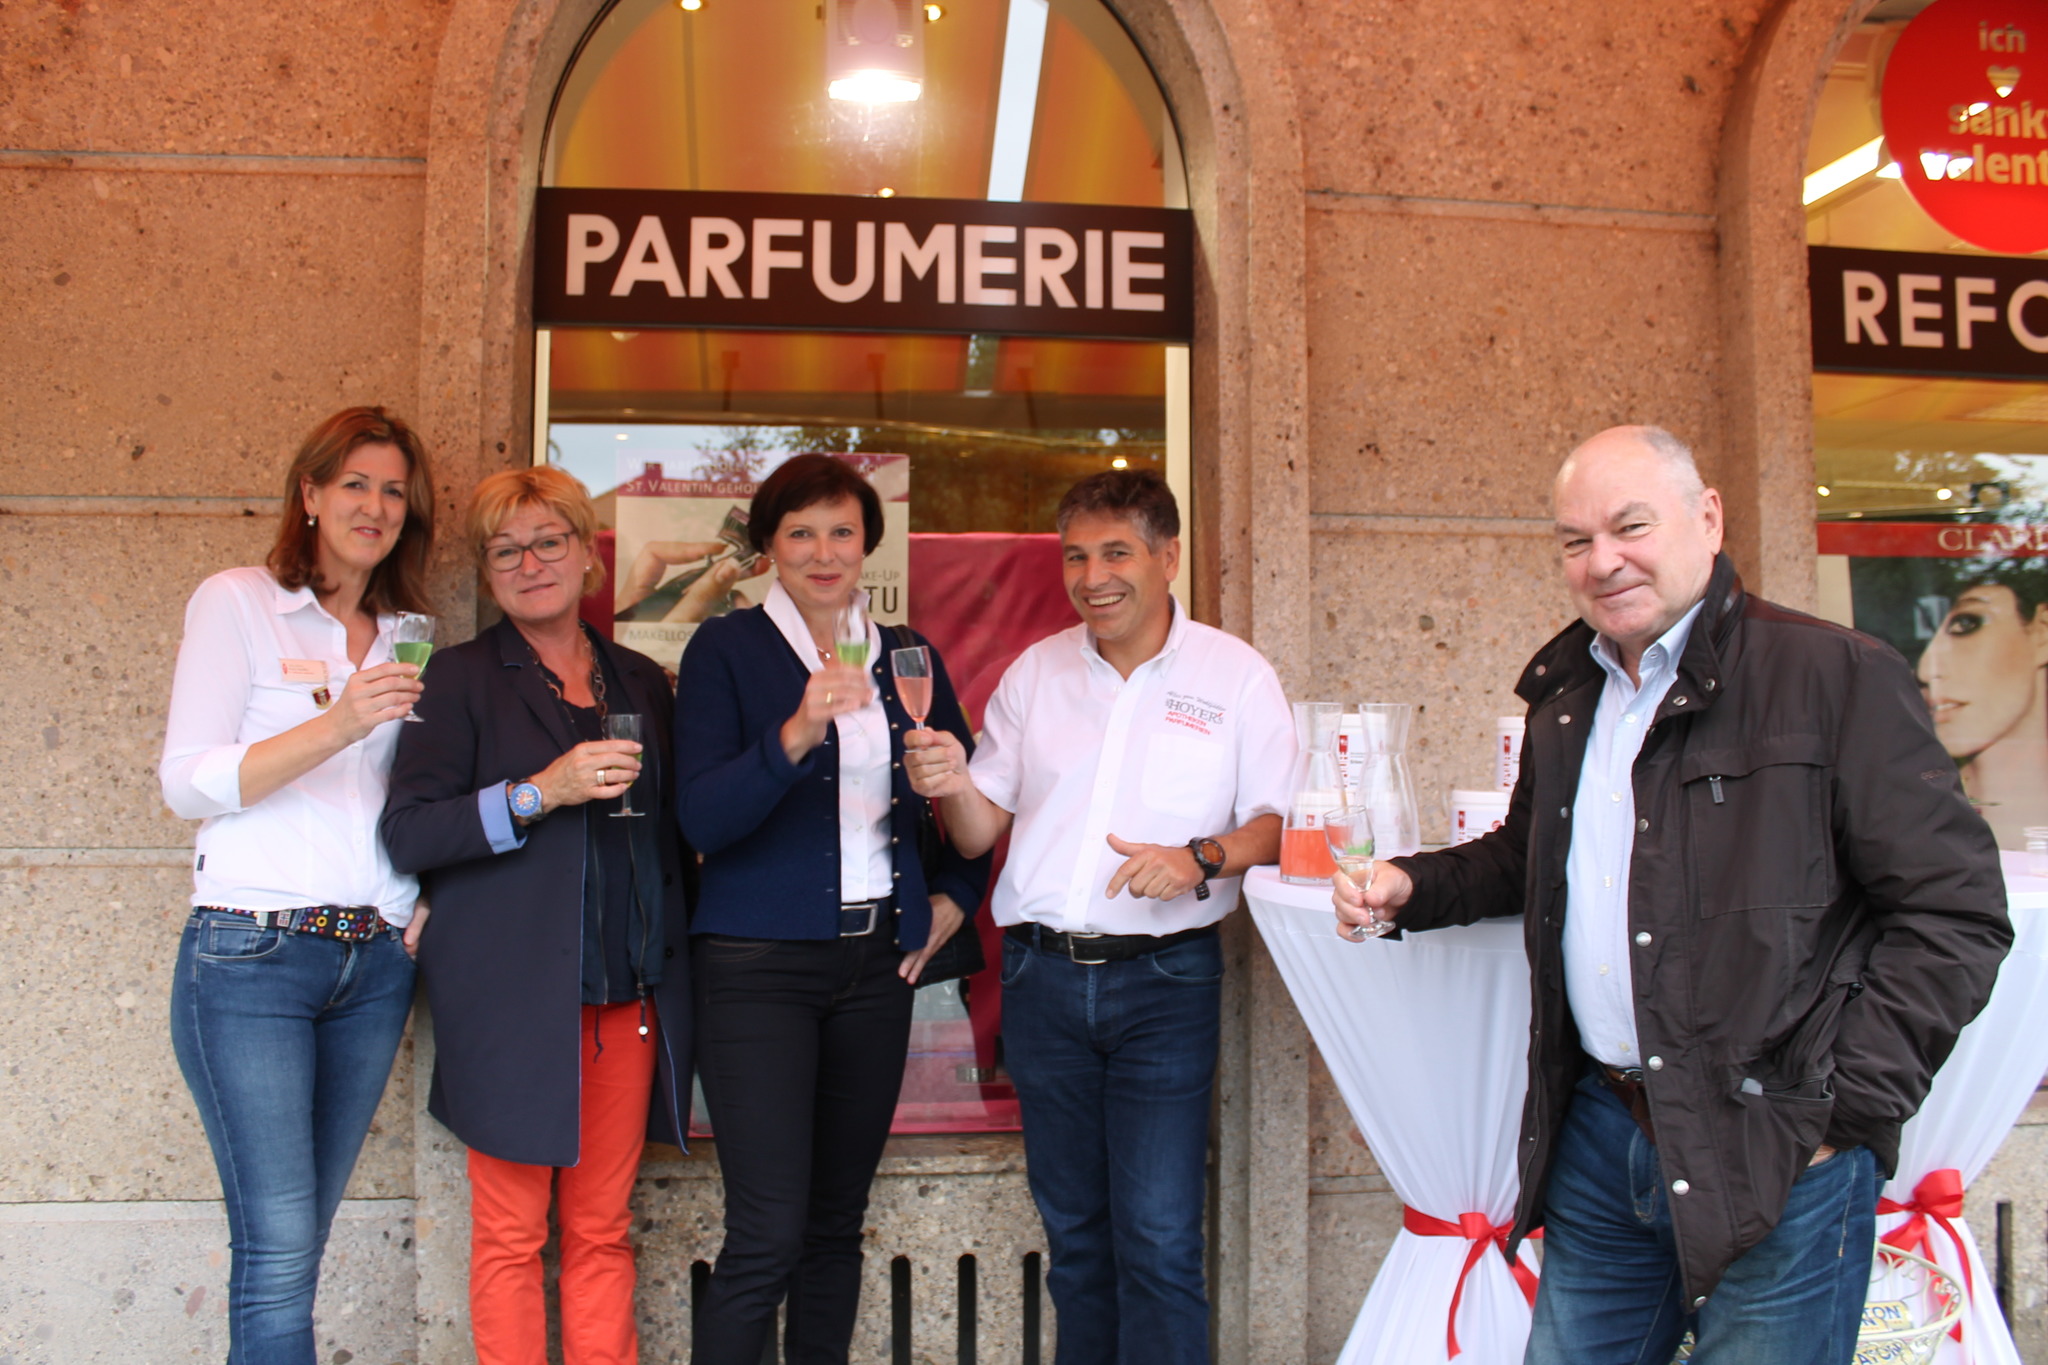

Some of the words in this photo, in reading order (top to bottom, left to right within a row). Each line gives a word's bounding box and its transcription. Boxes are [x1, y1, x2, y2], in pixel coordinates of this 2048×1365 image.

[1978, 21, 2026, 53] ich
[1948, 101, 2048, 139] sank
[566, 214, 1165, 311] PARFUMERIE
